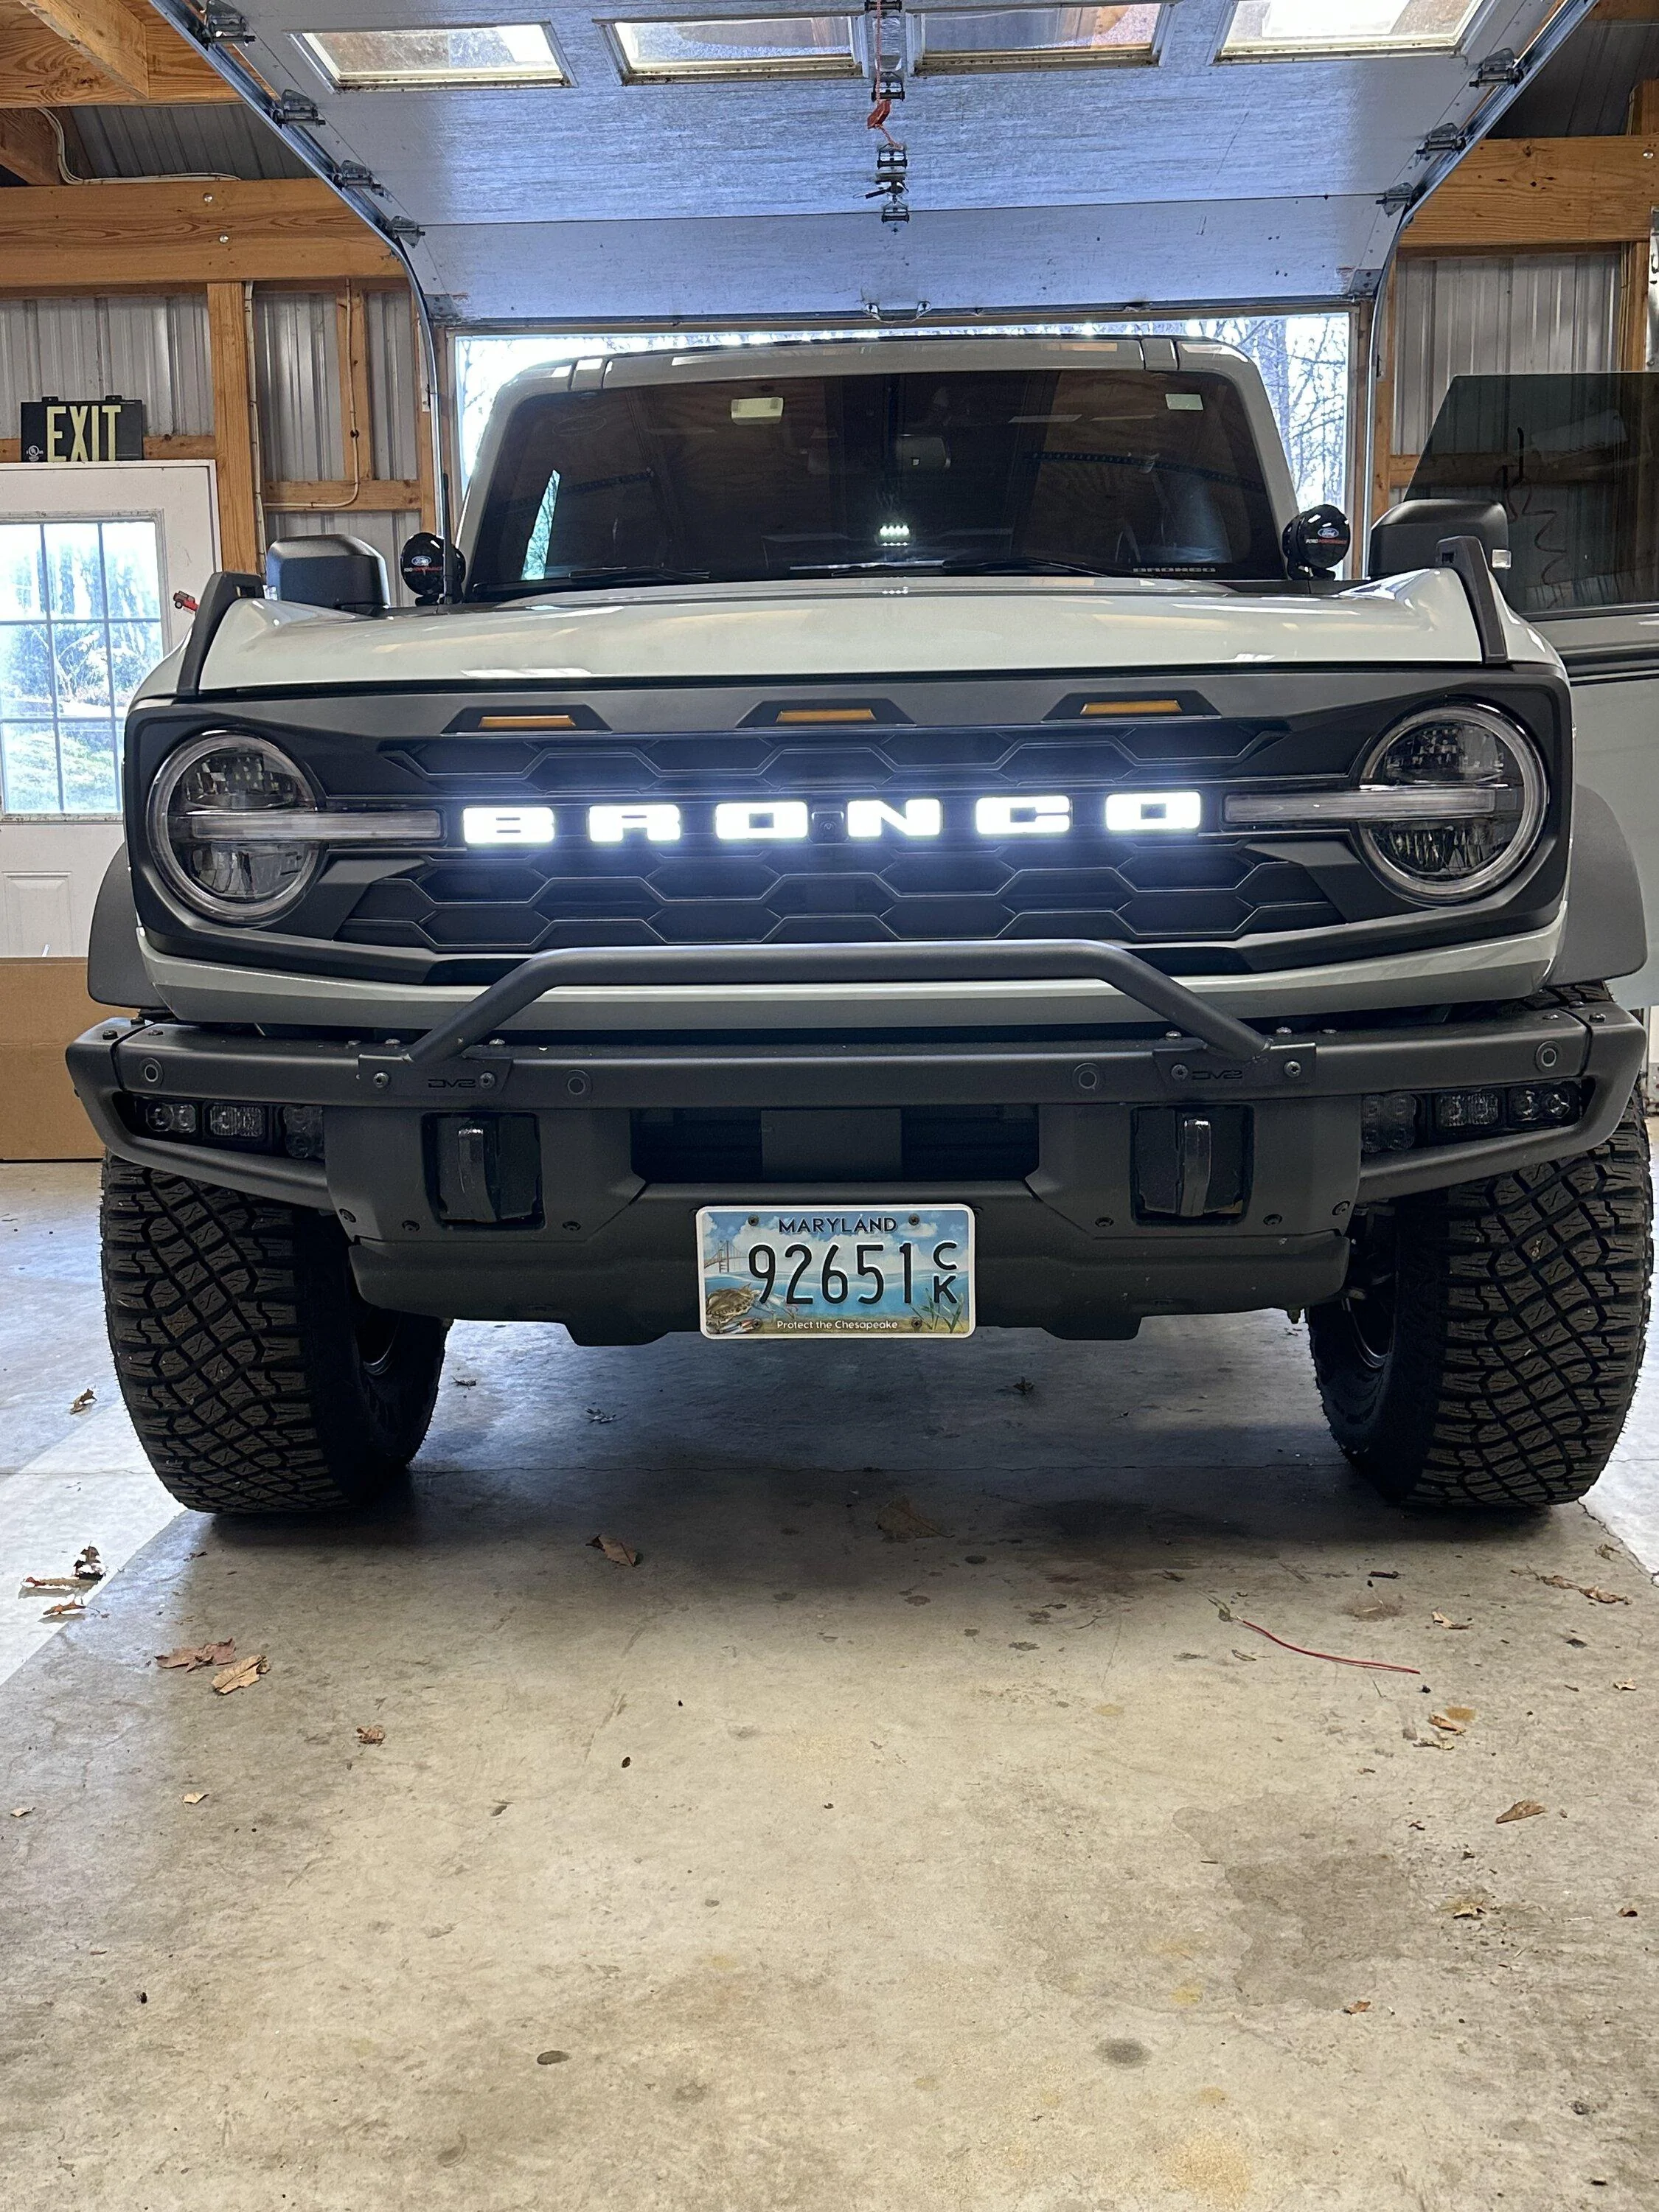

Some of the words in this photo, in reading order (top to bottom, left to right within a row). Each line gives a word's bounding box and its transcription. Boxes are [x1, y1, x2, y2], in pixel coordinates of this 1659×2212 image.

[46, 405, 122, 462] EXIT
[462, 791, 1202, 844] BRONCO
[778, 1217, 897, 1234] MARYLAND
[748, 1242, 913, 1305] 92651
[776, 1320, 813, 1329] Protect
[815, 1320, 832, 1329] the
[835, 1320, 898, 1330] Chesapeake
